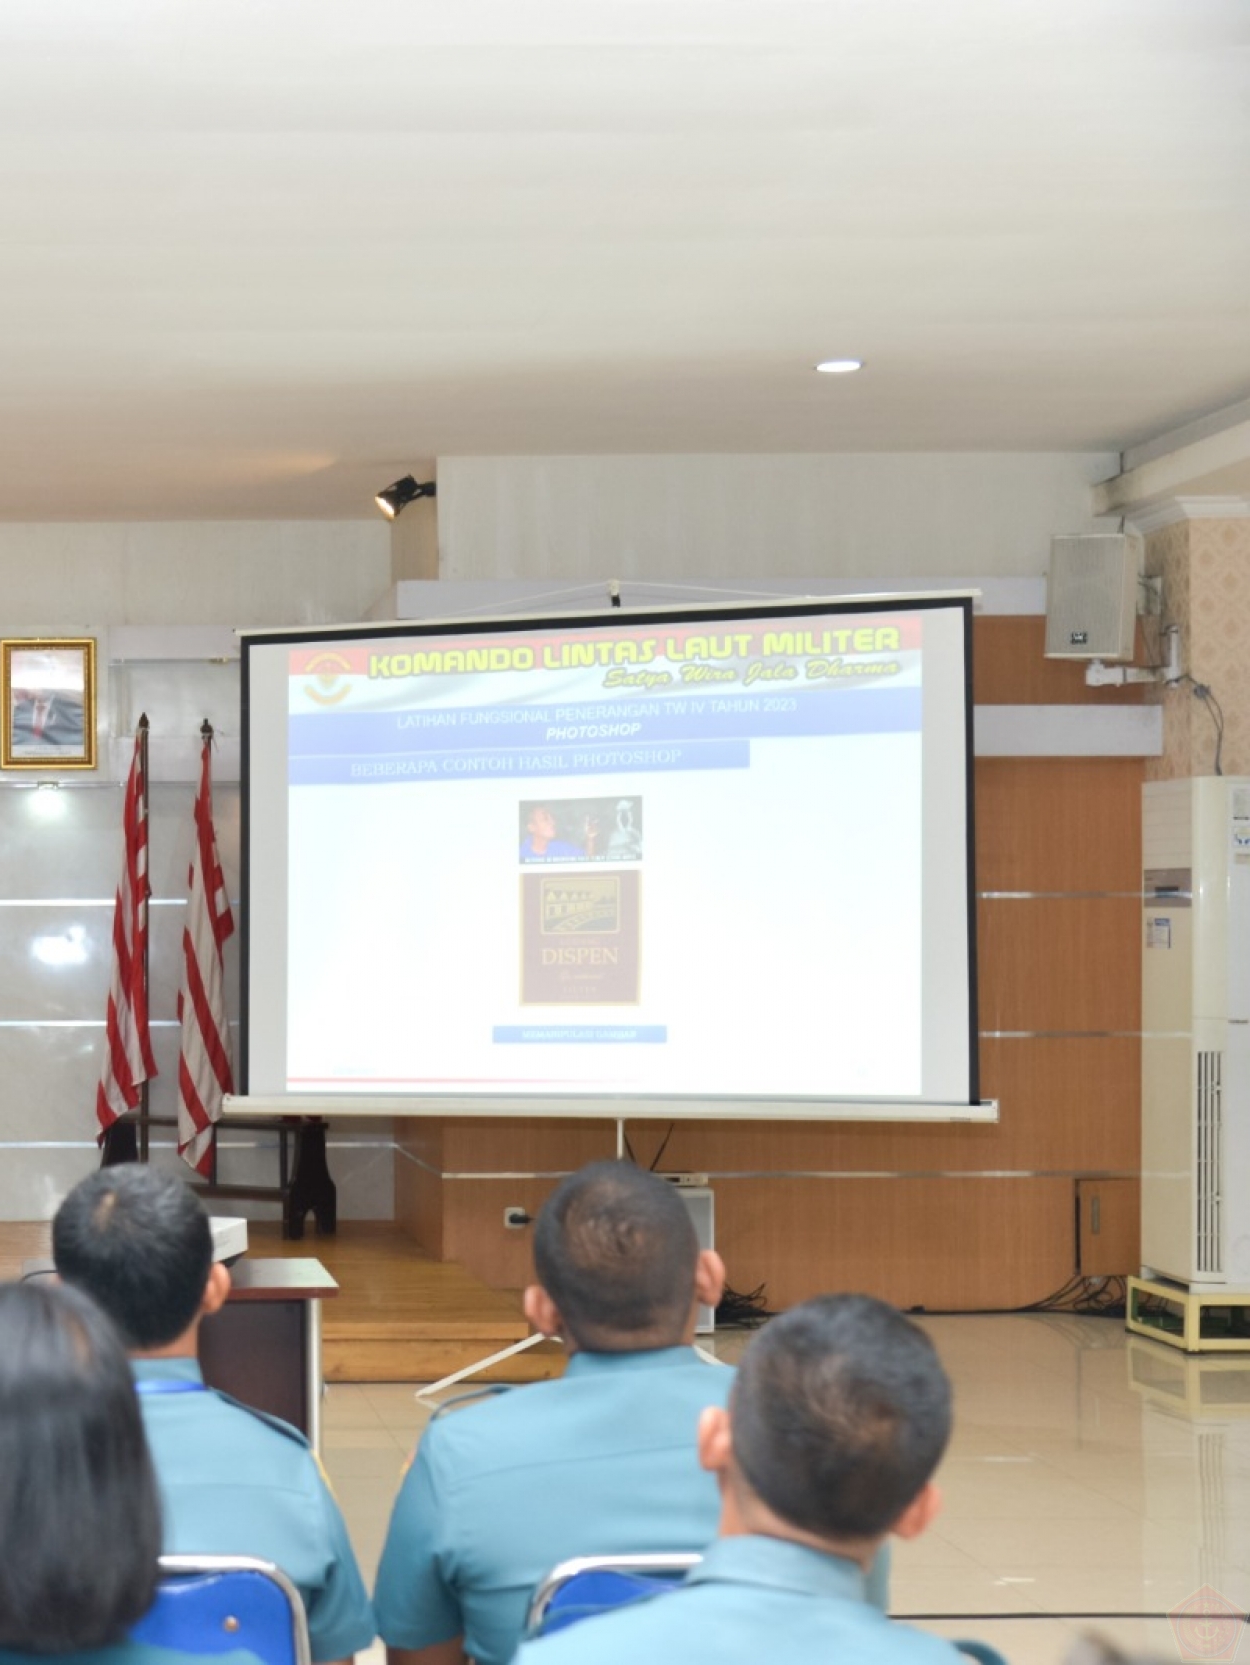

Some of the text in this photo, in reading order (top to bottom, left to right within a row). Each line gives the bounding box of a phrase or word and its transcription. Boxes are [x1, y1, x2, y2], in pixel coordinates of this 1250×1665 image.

[369, 626, 900, 678] KOMANDO LINTAS LAUT MILITER
[603, 658, 902, 688] Satya Wira Jala Dharma
[397, 697, 798, 729] LATIHAN FUNGSIONAL PENERANGAN TW IV TAHUN 2023
[546, 722, 642, 741] PHOTOSHOP
[350, 749, 682, 777] BEBERAPA CONTOH HASIL PHOTOSHOP
[540, 947, 619, 966] DISPEN
